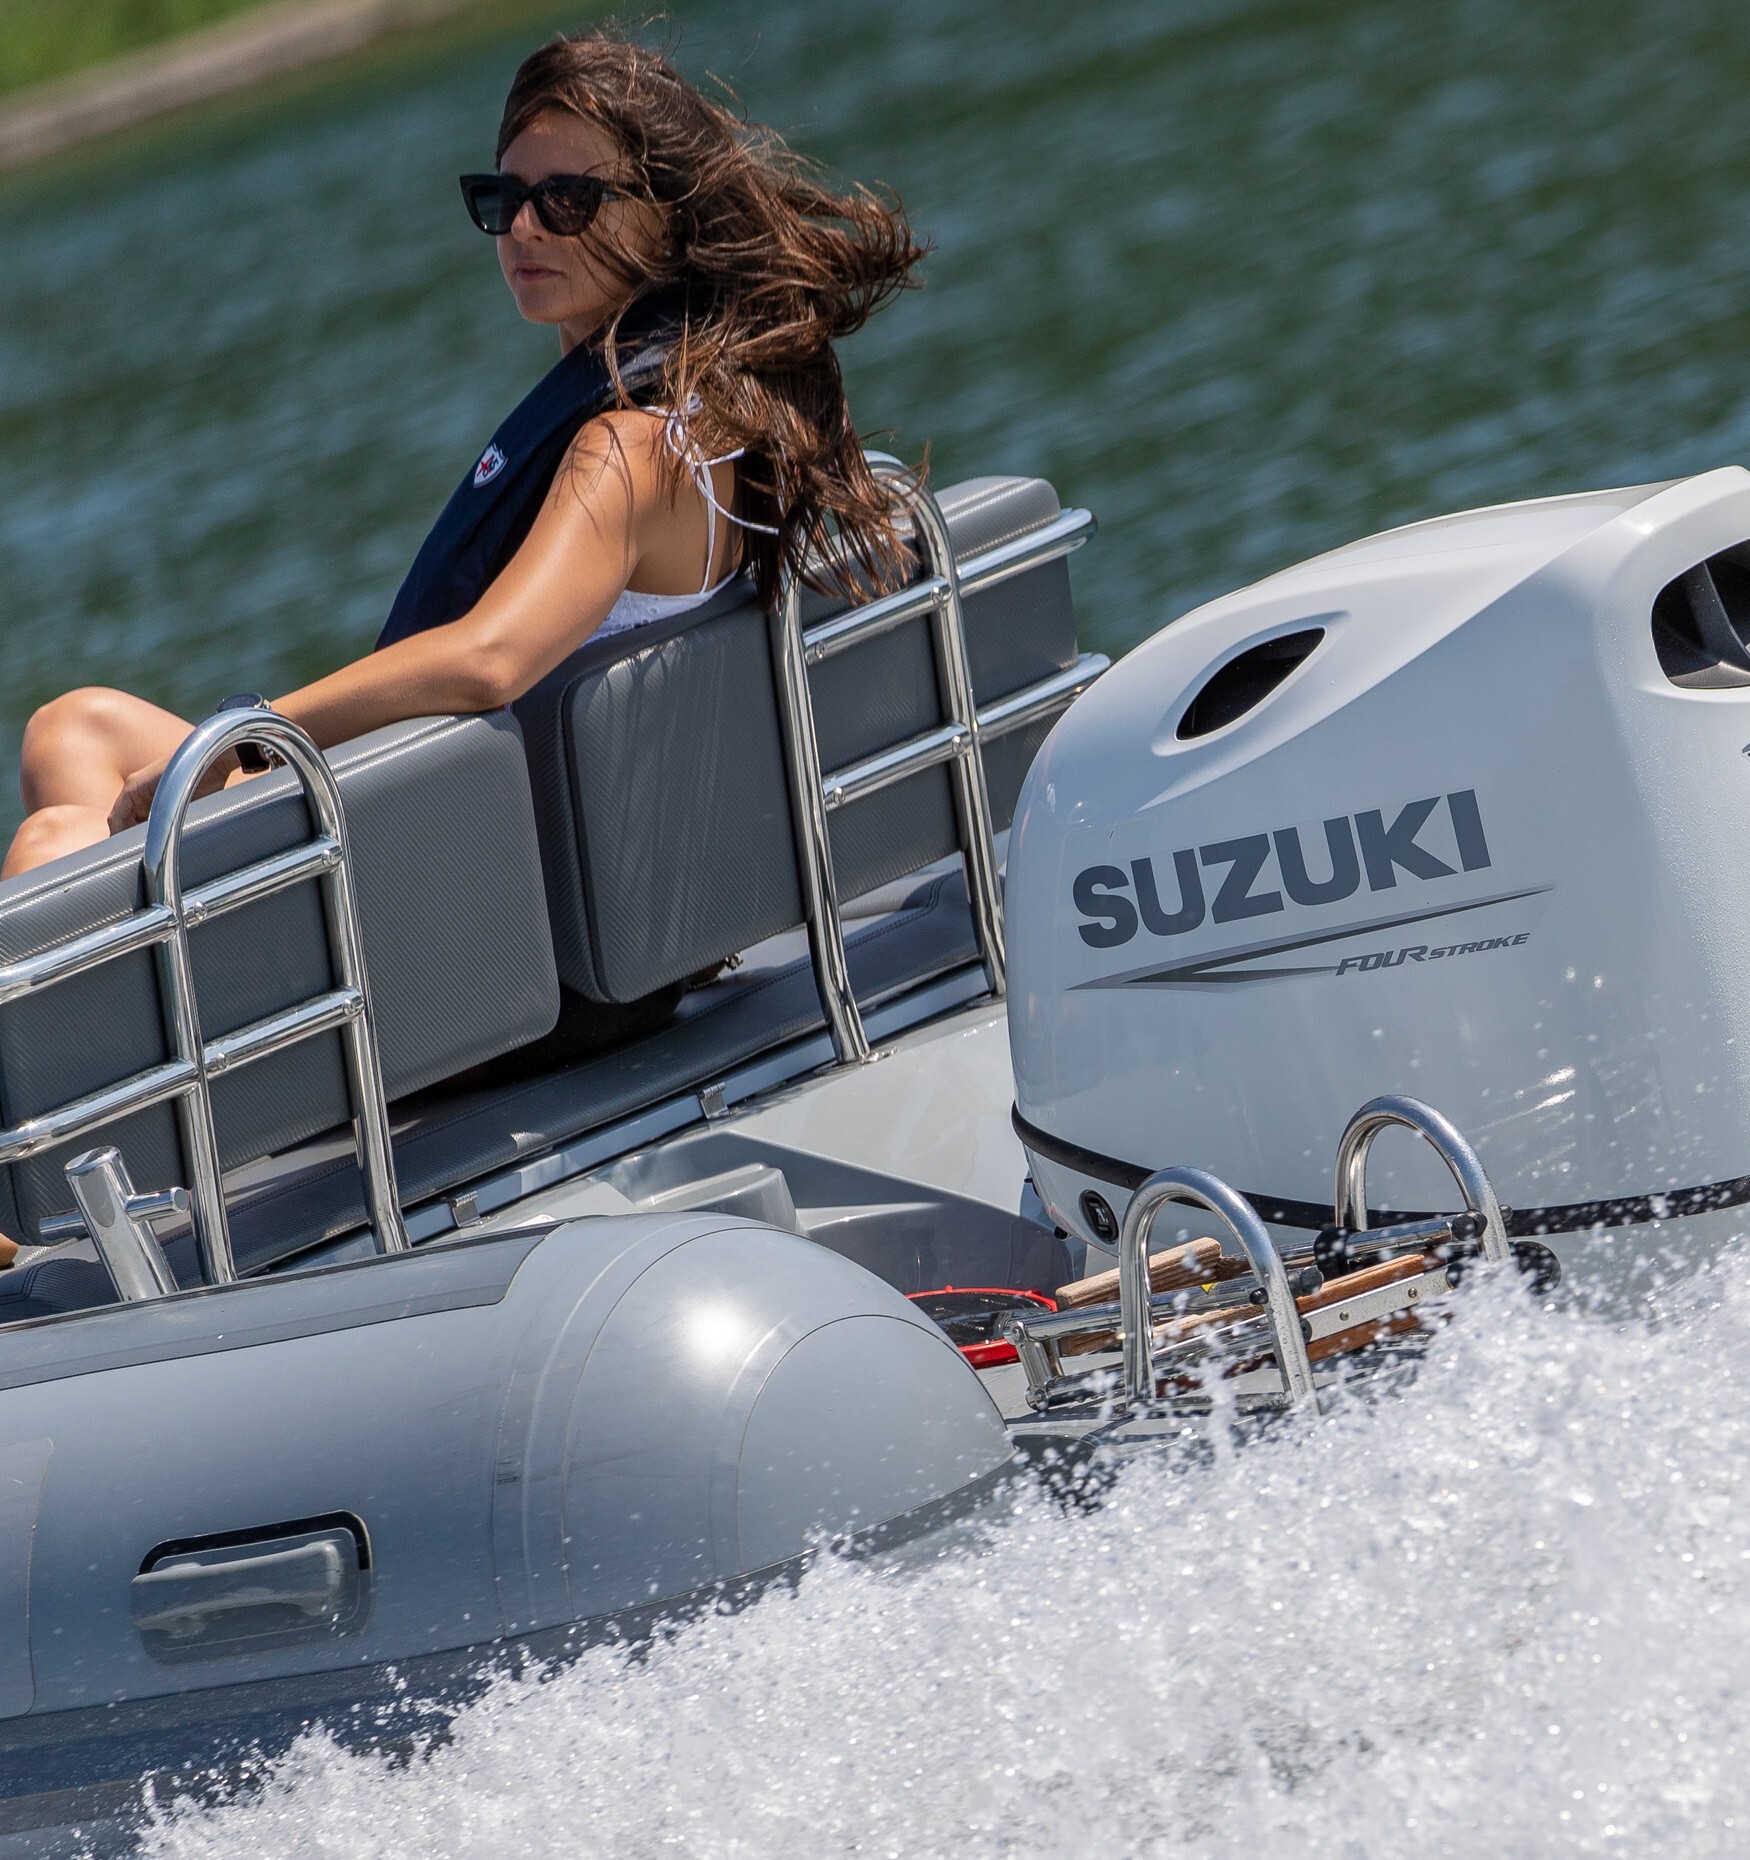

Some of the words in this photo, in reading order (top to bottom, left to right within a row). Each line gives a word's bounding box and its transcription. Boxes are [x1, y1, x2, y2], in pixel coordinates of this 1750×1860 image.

[1072, 788, 1492, 949] SUZUKI
[1335, 945, 1428, 976] FOUR
[1428, 932, 1531, 960] STROKE
